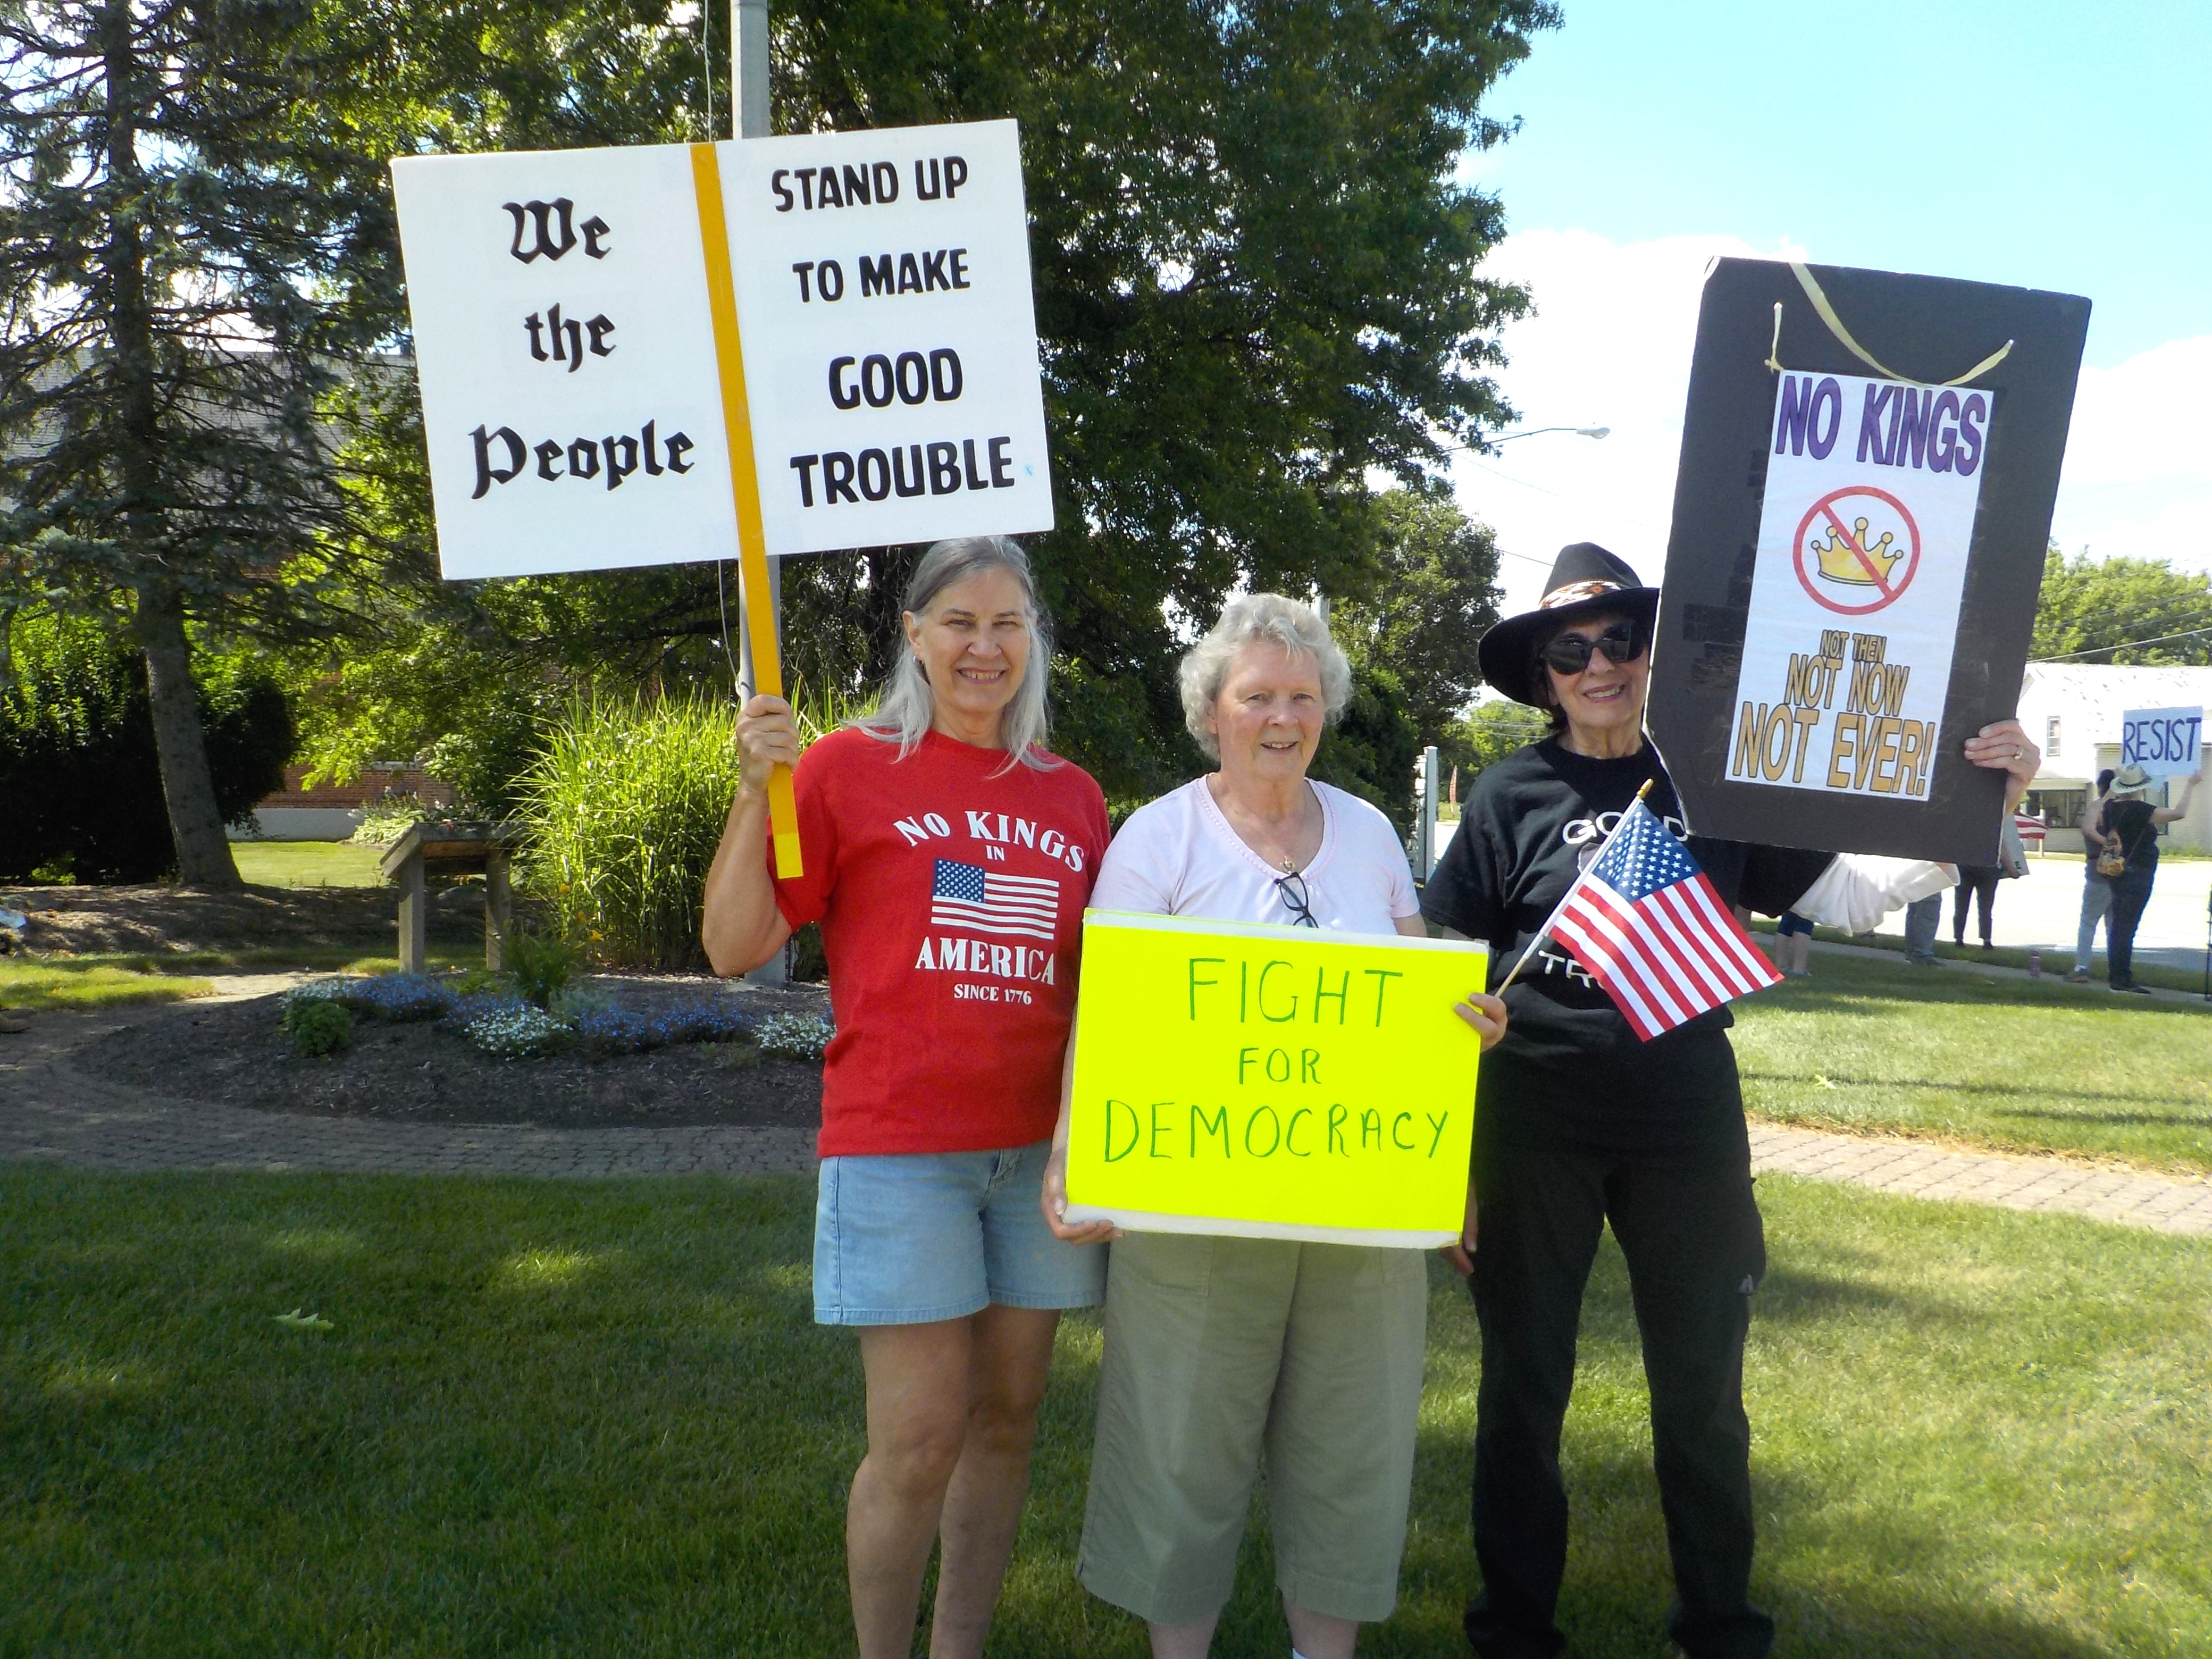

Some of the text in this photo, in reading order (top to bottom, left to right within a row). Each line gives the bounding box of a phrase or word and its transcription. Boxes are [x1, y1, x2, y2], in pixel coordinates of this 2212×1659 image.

[772, 156, 968, 212] STAND UP
[502, 197, 612, 264] We
[792, 249, 970, 303] TO MAKE
[524, 303, 617, 373] the
[828, 349, 963, 409] GOOD
[1775, 376, 1985, 475] NO KINGS
[468, 418, 695, 499] People
[790, 436, 1015, 507] TROUBLE
[1820, 630, 1887, 663] NOT THEN
[1784, 653, 1910, 717] NOT NOW
[1732, 701, 1936, 796] NOT EVER!
[2122, 717, 2201, 763] RESIST
[893, 810, 1084, 873] NO KINGS
[986, 845, 1005, 861] IN
[915, 936, 1054, 985] AMERICA
[954, 984, 1032, 1004] SINCE 1776
[1189, 958, 1403, 1027] FIGHT
[1239, 1048, 1321, 1084] FOR
[1104, 1100, 1448, 1162] DEMOCRACY
